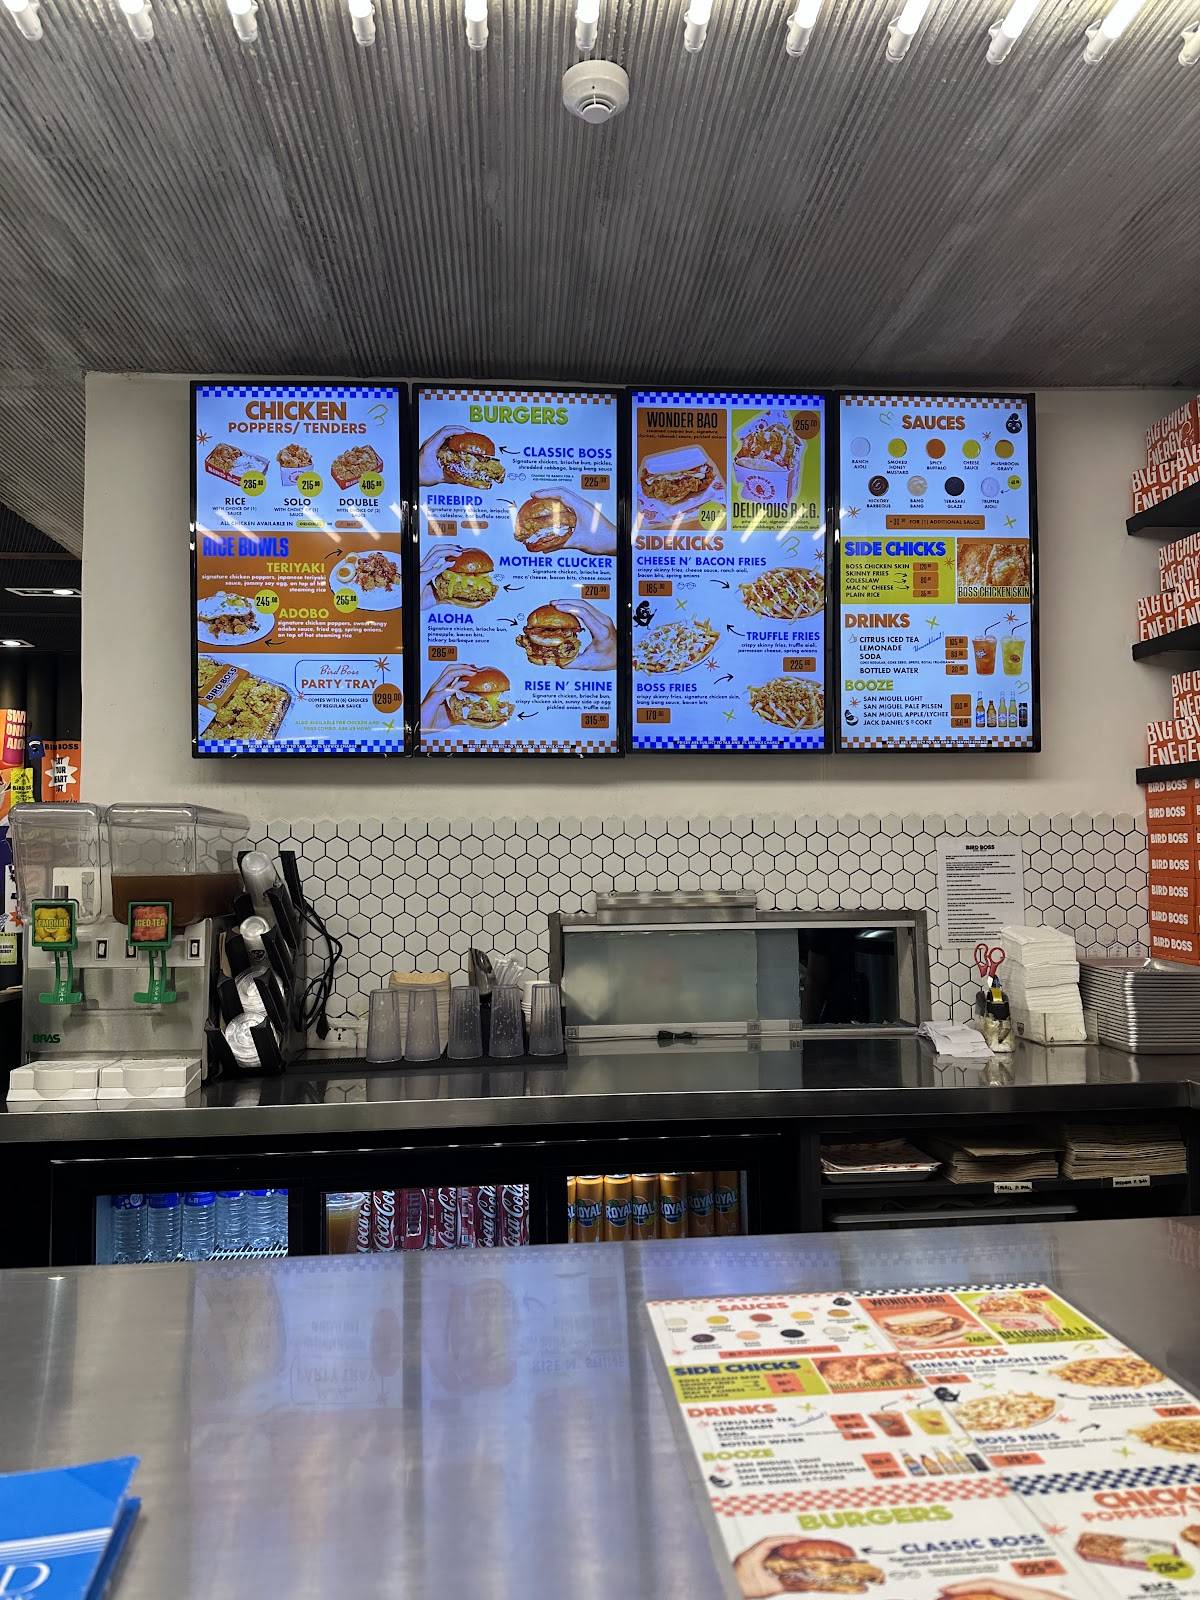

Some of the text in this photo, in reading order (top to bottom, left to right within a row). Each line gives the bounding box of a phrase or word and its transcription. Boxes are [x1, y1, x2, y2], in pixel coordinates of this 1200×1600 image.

[245, 401, 346, 420] CHICKEN
[470, 405, 568, 425] BURGERS
[647, 412, 717, 428] WONDER BAO
[902, 415, 965, 430] SAUCES
[1146, 402, 1192, 450] BIG CHICK
[228, 422, 366, 434] POPPERS/ TENDERS
[524, 447, 612, 458] CLASSIC BOSS
[1147, 430, 1182, 468] ENERGY
[1132, 466, 1157, 492] BIG
[427, 494, 482, 506] FIREBIRD
[733, 502, 787, 518] DELICIOUS
[203, 538, 288, 557] RICE BOWLS
[635, 536, 723, 551] SIDEKICKS
[845, 542, 946, 556] SIDE CHICKS
[499, 557, 611, 568] MOTHER CLUCKER
[637, 557, 766, 566] CHEESE N' BACON FRIES
[1159, 545, 1174, 570] BIG
[267, 562, 325, 572] TERIYAKI
[958, 586, 1029, 598] BOSS CHICKEN SKIN
[279, 609, 329, 618] ADOBO
[1138, 595, 1160, 621] BIG
[428, 614, 473, 623] ALOHA
[845, 614, 910, 628] DRINKS
[747, 632, 820, 640] TRUFFLE FRIES
[302, 680, 377, 688] PARTY TRAY
[525, 681, 612, 691] RISE N' SHINE
[637, 684, 665, 692] BOSS
[846, 679, 893, 691] BOOZE
[1172, 673, 1190, 697] BIG
[1148, 721, 1173, 745] BIG
[1151, 833, 1188, 843] BIRD BOSS
[1152, 859, 1189, 870] BIRD BOSS
[1152, 911, 1188, 924] BIRD BOSS
[1153, 936, 1192, 951] BIRD BOSS
[718, 1302, 789, 1311] SAUCES
[674, 1361, 801, 1375] SIDE CHICKS
[688, 1404, 777, 1418] DRINKS
[1020, 1432, 1060, 1441] FRIES
[797, 1505, 953, 1530] BURGERS
[901, 1535, 1045, 1554] CLASSIC BOSS
